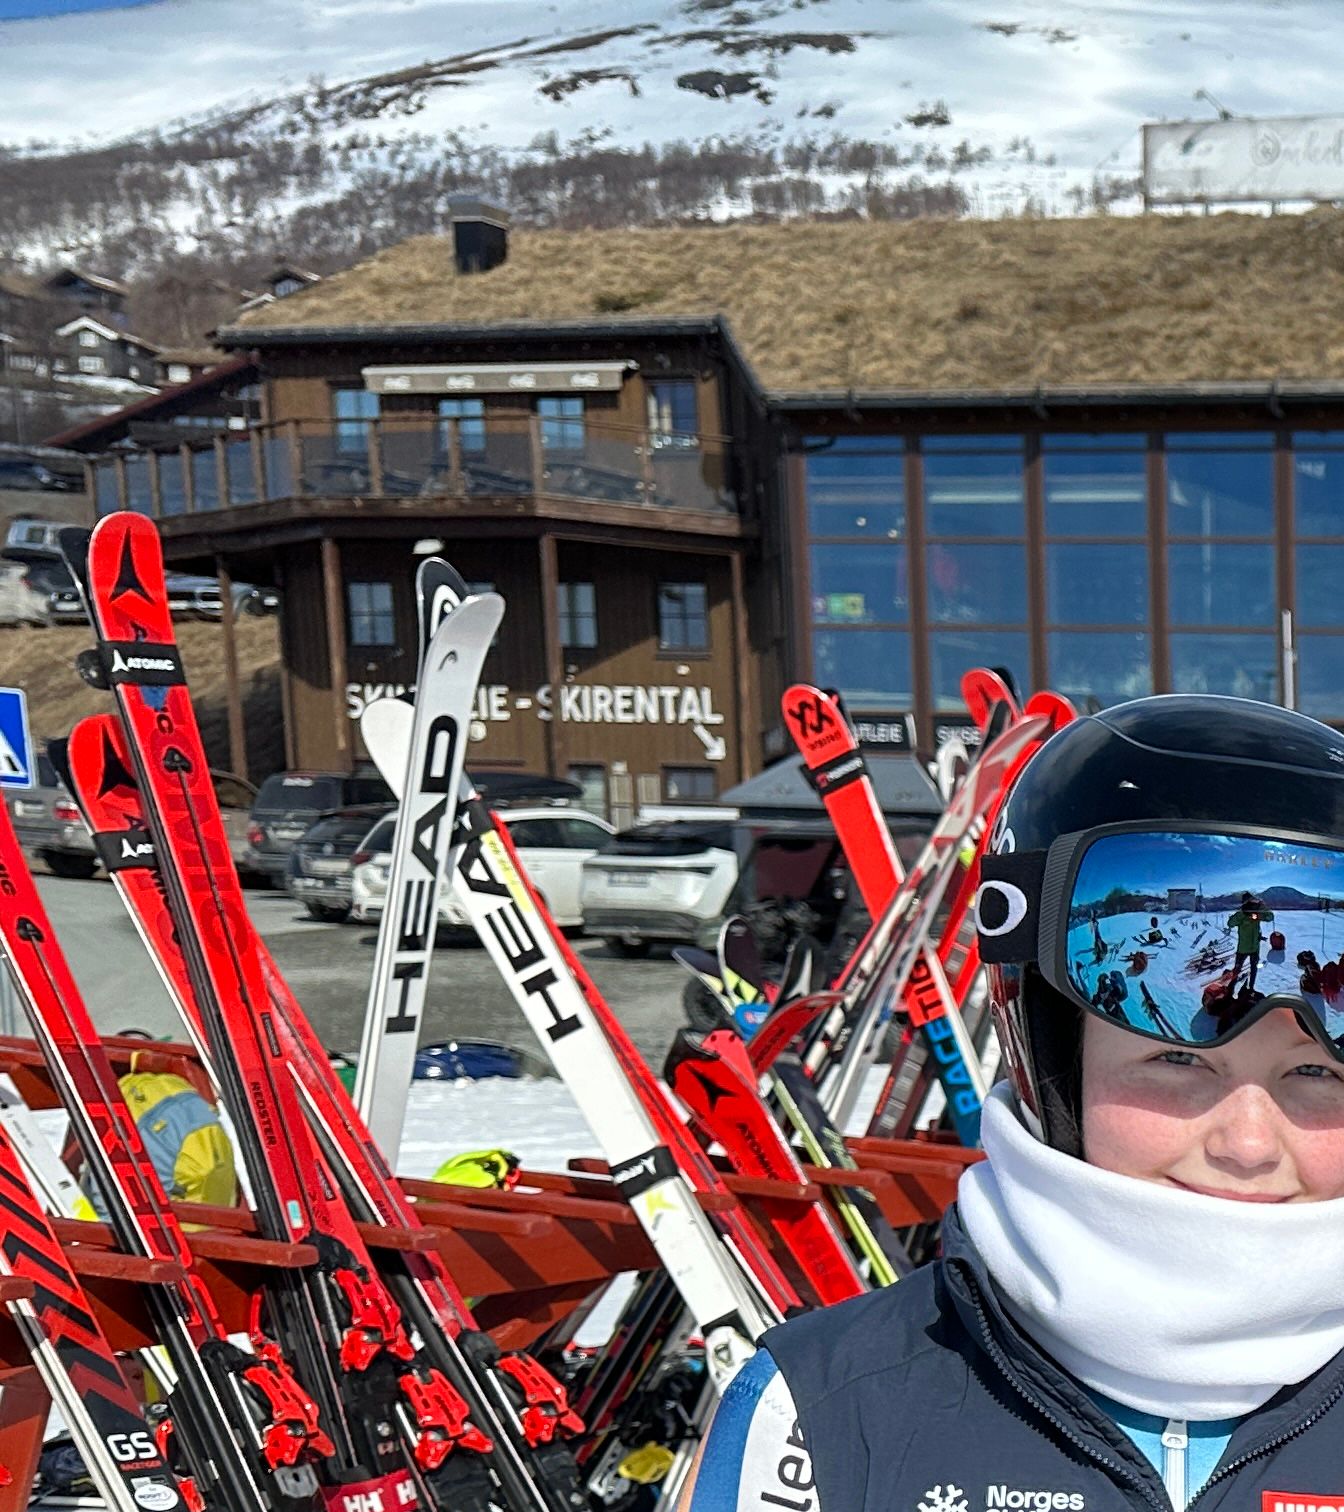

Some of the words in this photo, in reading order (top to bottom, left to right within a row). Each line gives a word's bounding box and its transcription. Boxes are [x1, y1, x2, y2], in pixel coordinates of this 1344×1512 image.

[536, 683, 724, 725] SKIRENTAL
[385, 714, 459, 1034] HEAD
[457, 834, 584, 1043] HEA
[106, 1431, 158, 1462] GS
[987, 1485, 1085, 1512] Norges
